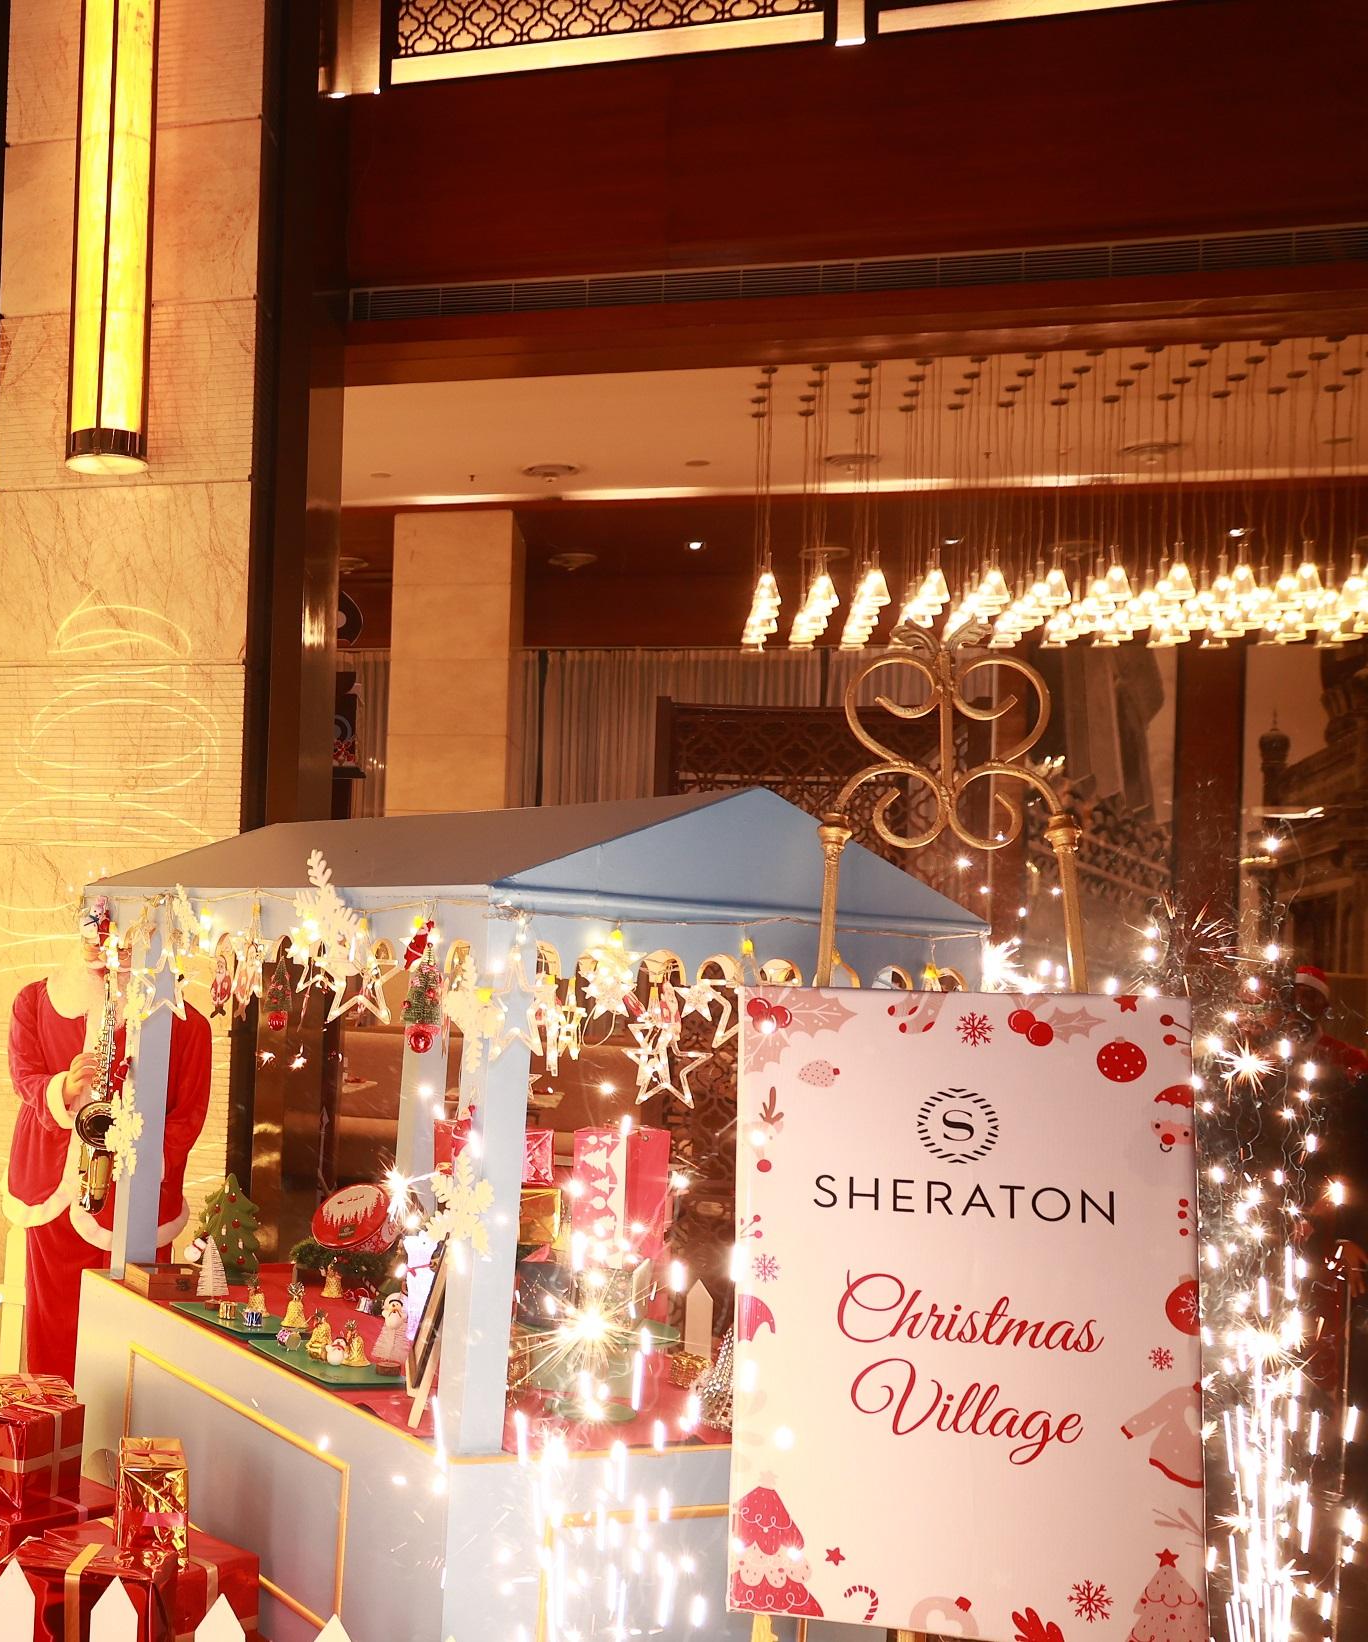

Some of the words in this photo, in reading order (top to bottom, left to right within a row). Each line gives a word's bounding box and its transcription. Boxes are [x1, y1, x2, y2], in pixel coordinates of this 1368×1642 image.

[942, 1109, 975, 1142] S
[813, 1174, 1115, 1226] SHERATON
[837, 1269, 1104, 1353] Christmas
[850, 1358, 1083, 1466] Village
